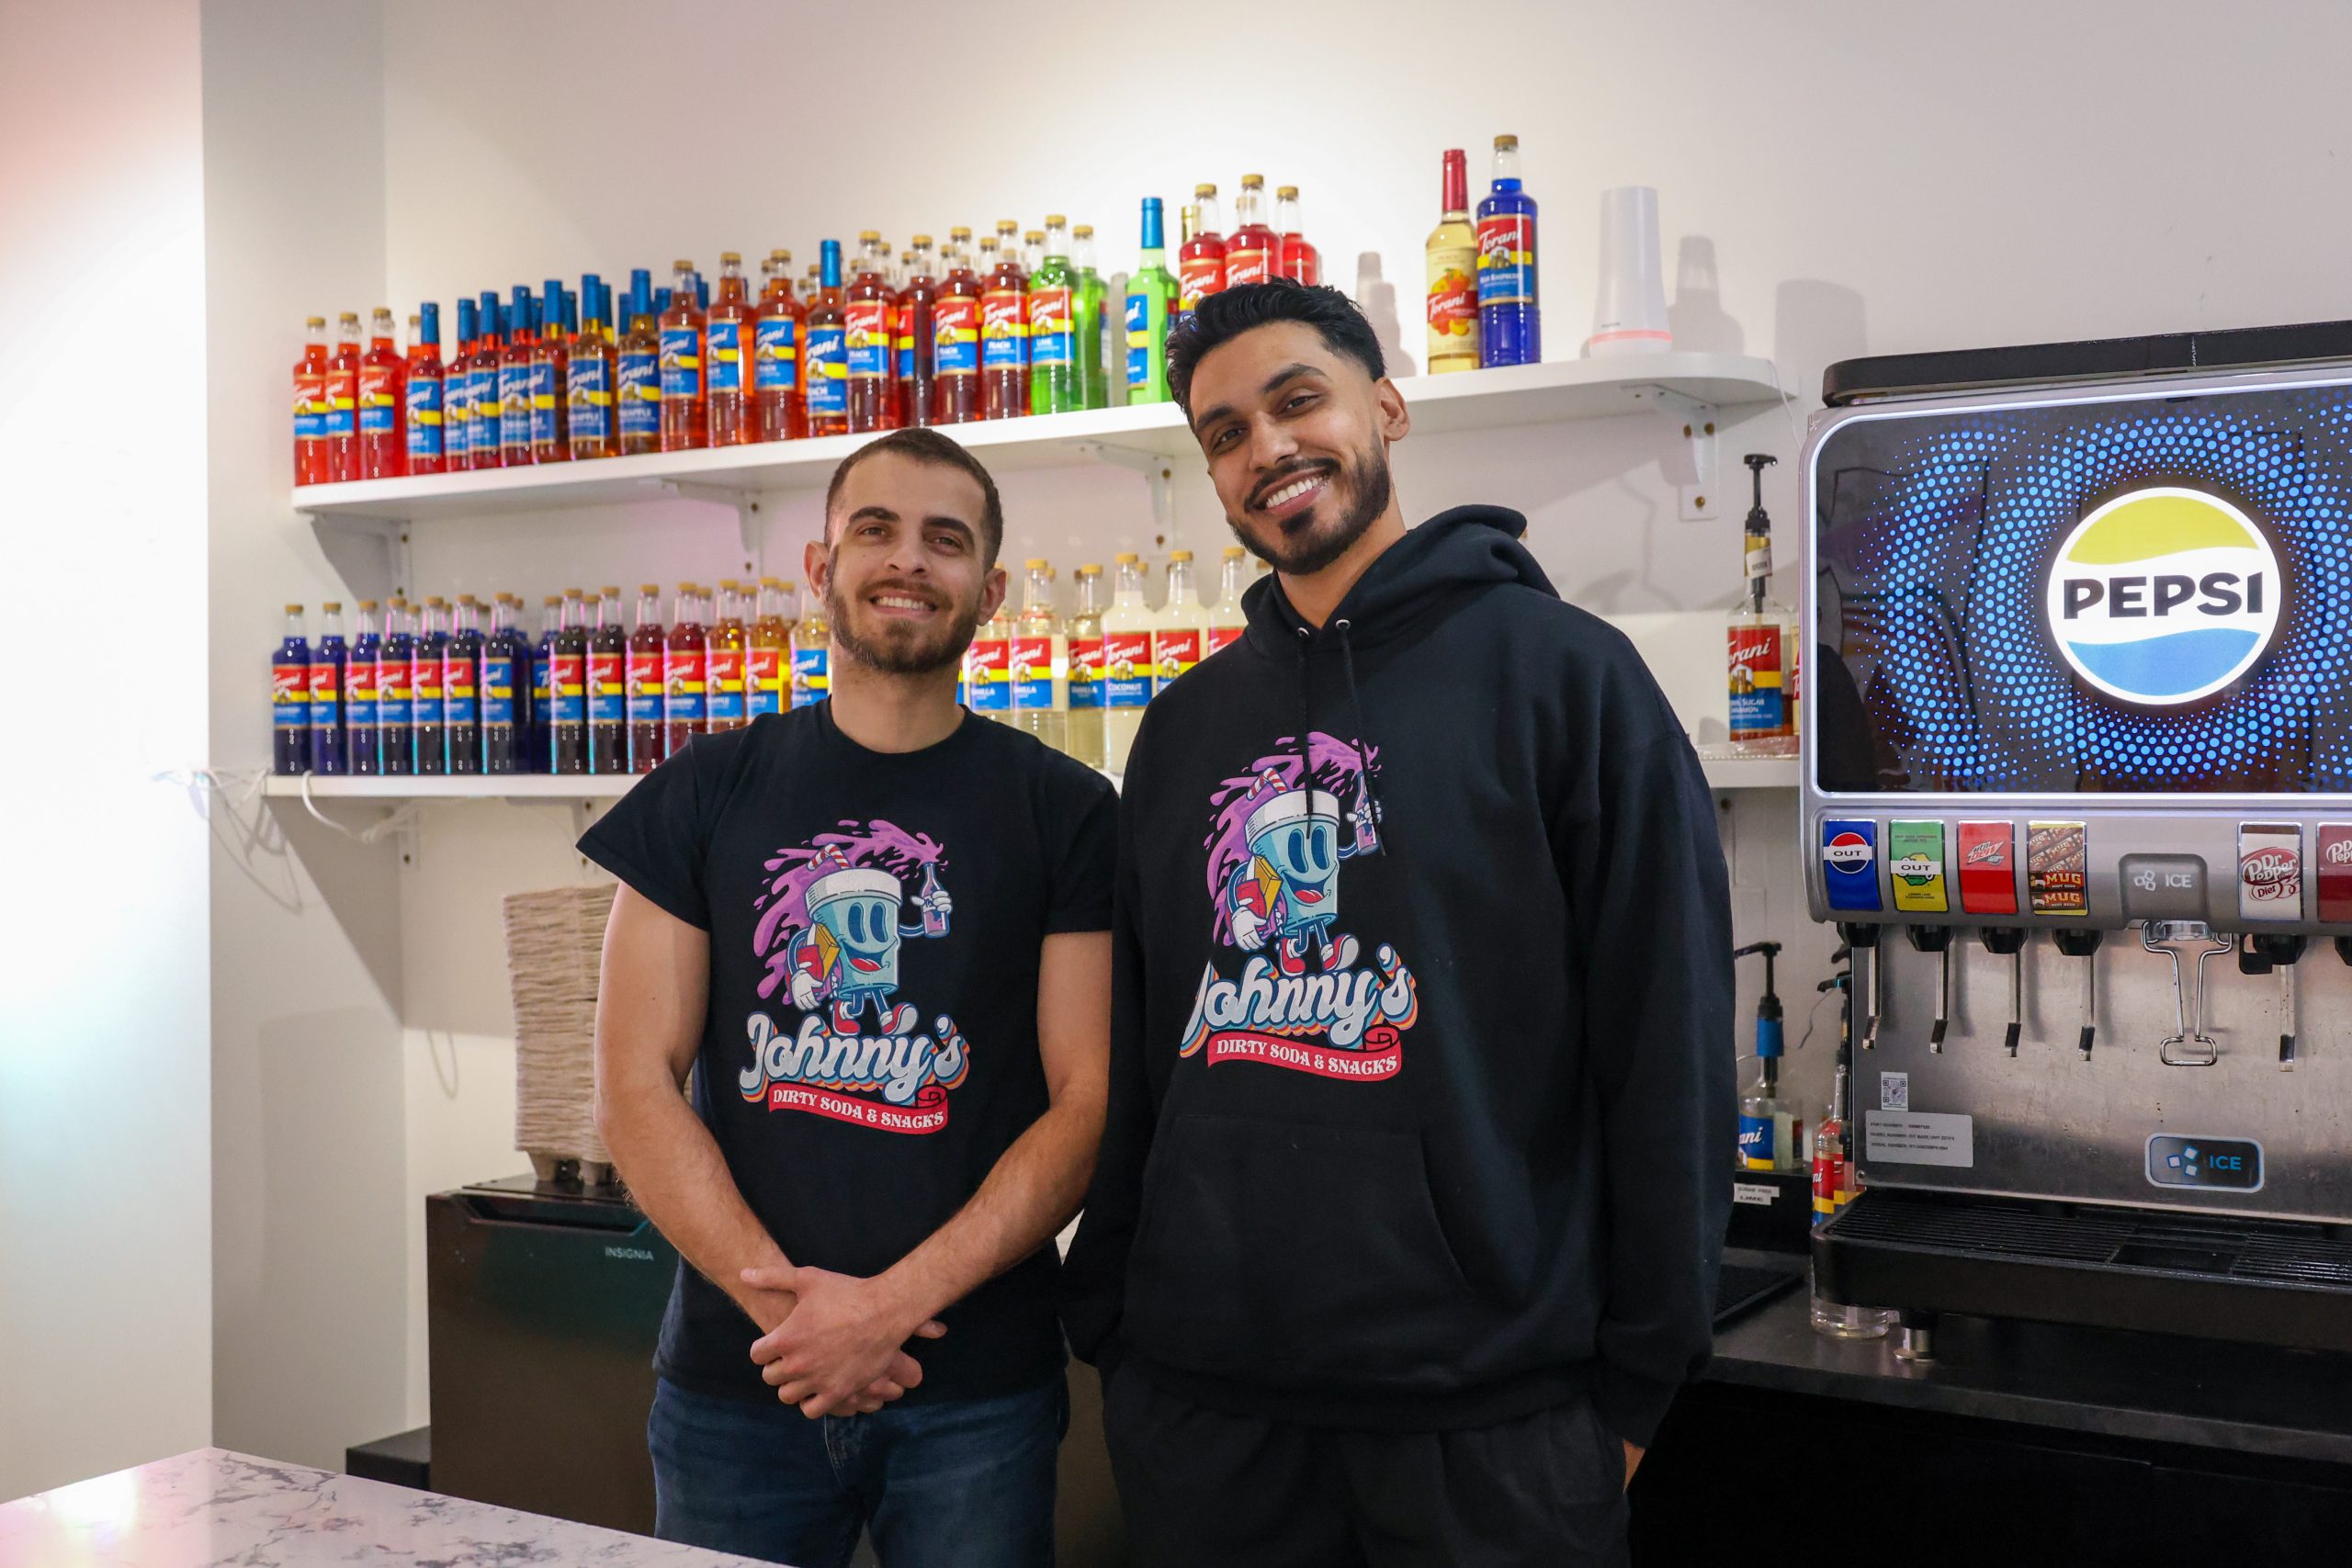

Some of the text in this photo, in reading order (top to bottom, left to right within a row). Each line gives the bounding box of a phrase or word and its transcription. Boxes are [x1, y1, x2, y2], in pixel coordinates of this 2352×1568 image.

[1429, 291, 1467, 321] Torani
[2064, 571, 2263, 619] PEPSI
[1104, 641, 1145, 664] Torani
[2243, 858, 2297, 882] Pepper
[2261, 853, 2282, 869] Dr
[2045, 873, 2082, 886] MUG
[2165, 874, 2192, 888] ICE
[2257, 884, 2278, 898] Diet
[2044, 892, 2081, 904] MUG
[1181, 945, 1412, 1047] Johnny's
[739, 1011, 965, 1103] Johnny's
[1217, 1039, 1397, 1076] DIRTY SODA & SNACKS
[773, 1088, 944, 1129] DIRTY SODA & SNACKS
[2210, 1155, 2242, 1170] ICE
[605, 1247, 654, 1260] INSIGNIA
